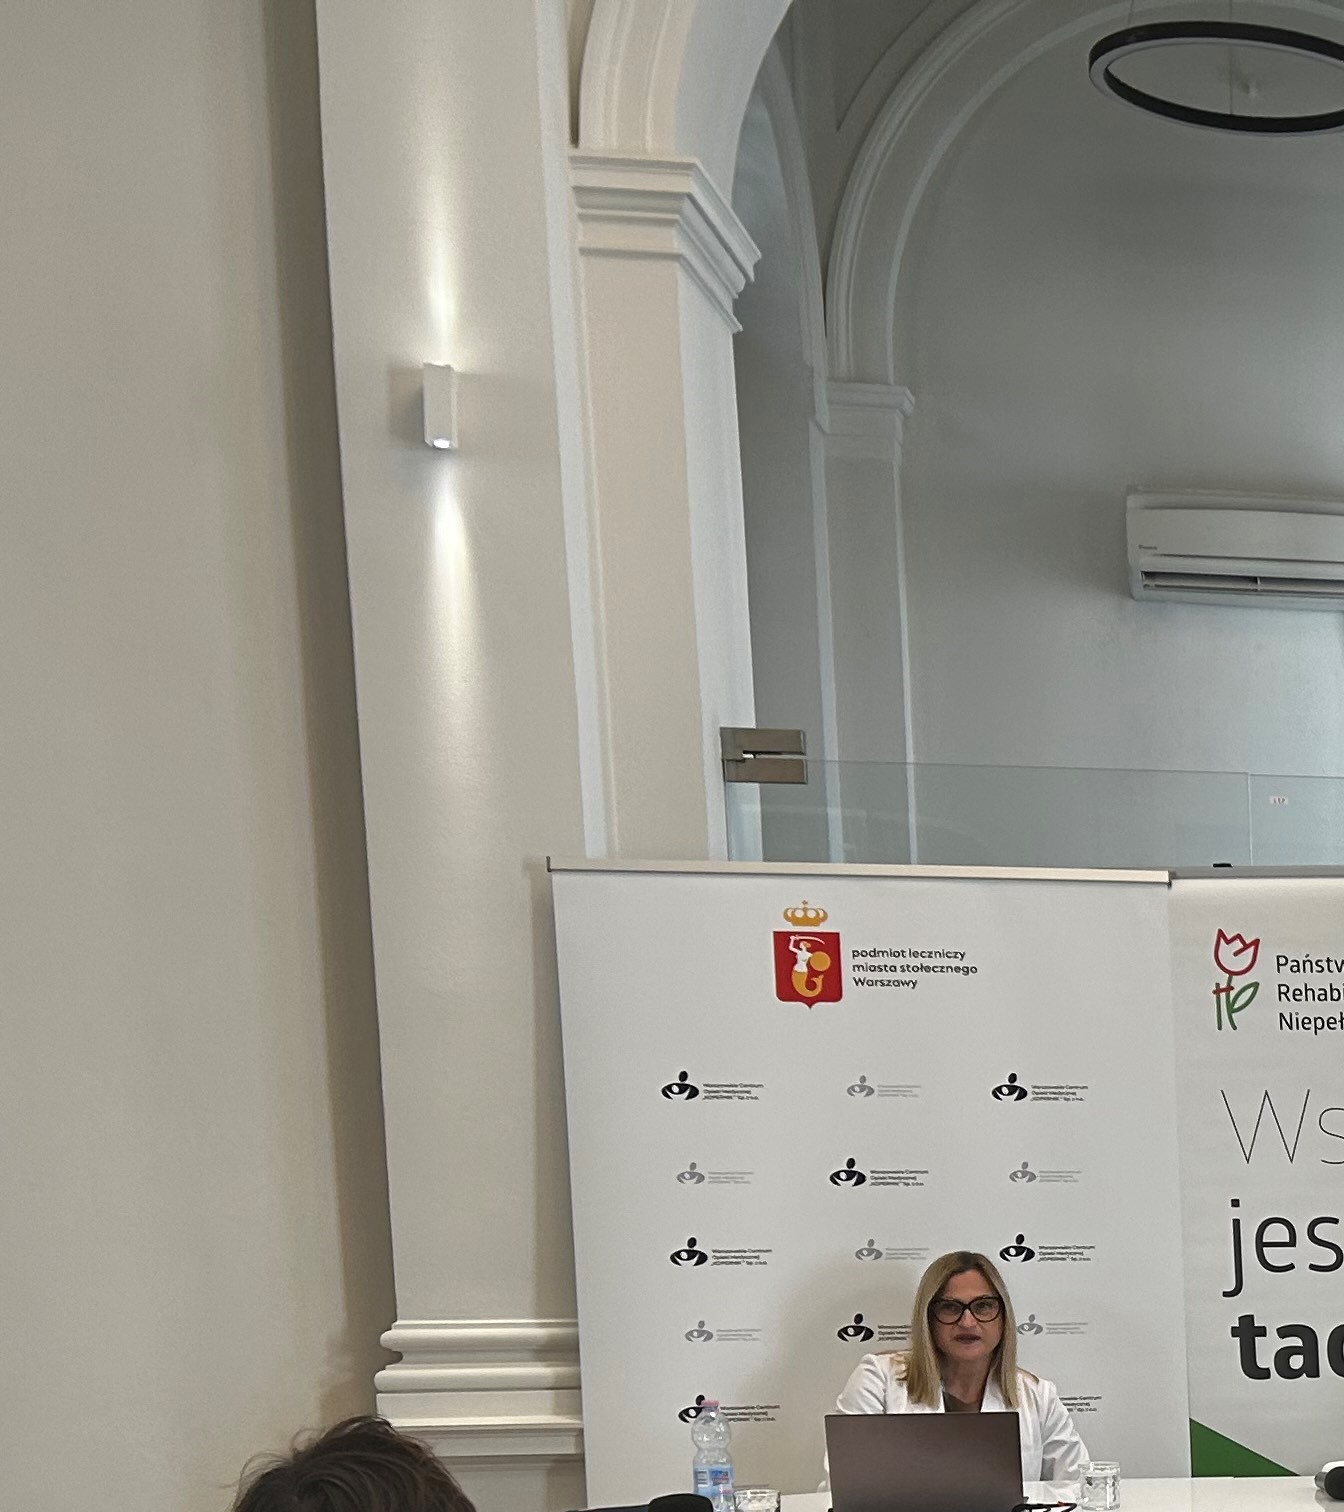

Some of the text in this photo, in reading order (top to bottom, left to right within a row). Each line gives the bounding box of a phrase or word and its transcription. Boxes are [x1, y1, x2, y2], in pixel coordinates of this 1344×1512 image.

[852, 948, 966, 961] podmiot leczniczy
[852, 963, 978, 976] miasta stołecznego
[852, 976, 918, 989] Warszawy
